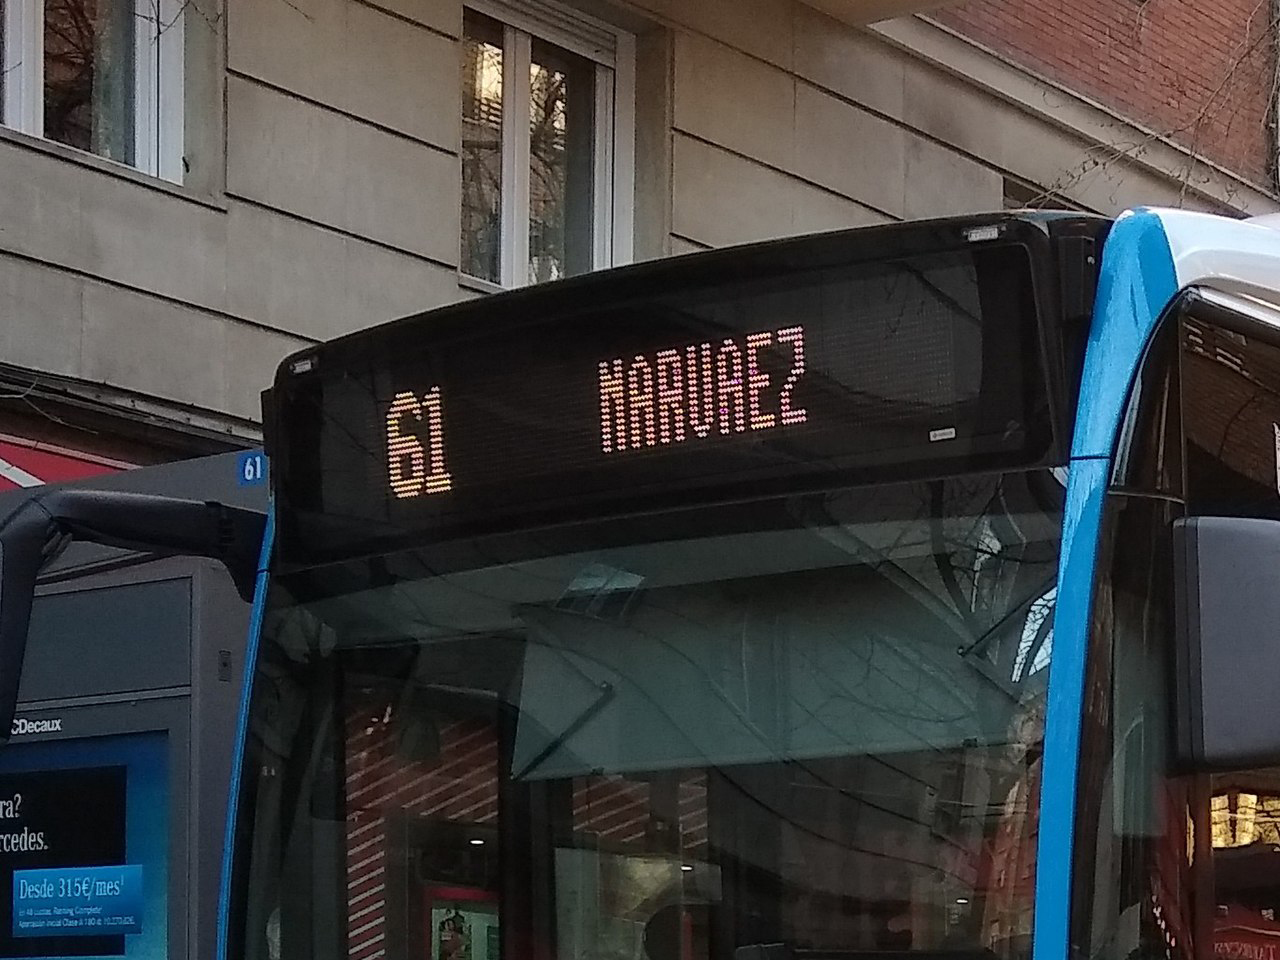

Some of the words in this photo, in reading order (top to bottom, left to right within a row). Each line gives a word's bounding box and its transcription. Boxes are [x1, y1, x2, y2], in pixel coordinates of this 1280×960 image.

[386, 386, 452, 498] 61
[599, 325, 807, 452] NARVAEZ
[244, 456, 262, 481] 61
[11, 718, 61, 735] CDecaux
[20, 879, 54, 899] Desde
